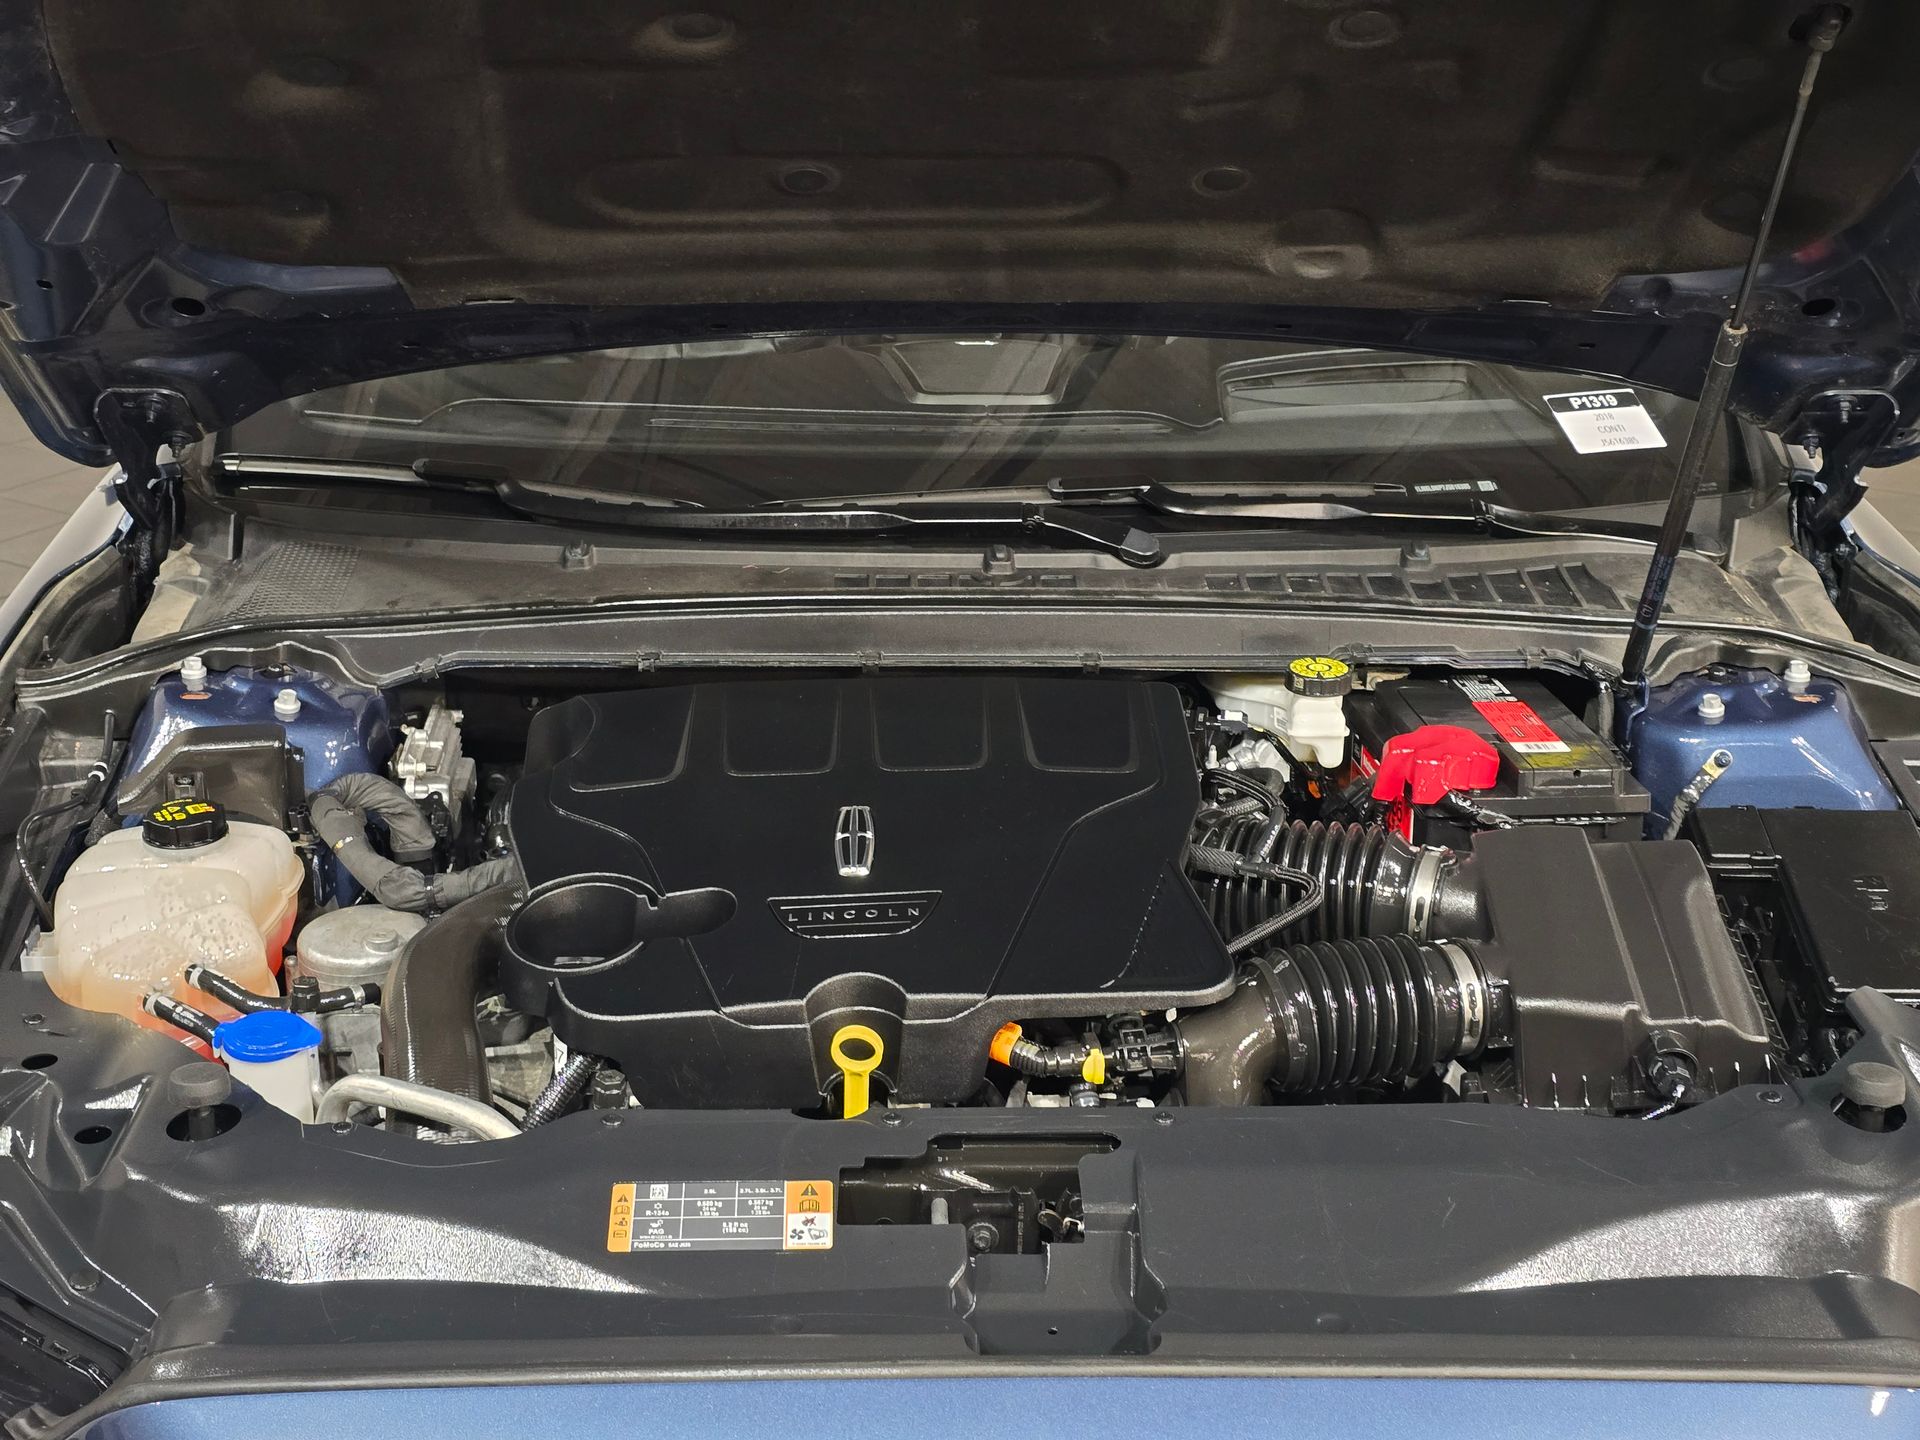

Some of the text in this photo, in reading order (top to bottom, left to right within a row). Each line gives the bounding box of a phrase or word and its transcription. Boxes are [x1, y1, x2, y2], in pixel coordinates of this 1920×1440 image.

[1568, 394, 1618, 409] P1319
[1594, 413, 1615, 421] 2018
[1597, 424, 1627, 434] CONTI
[787, 907, 920, 922] LINCOLN
